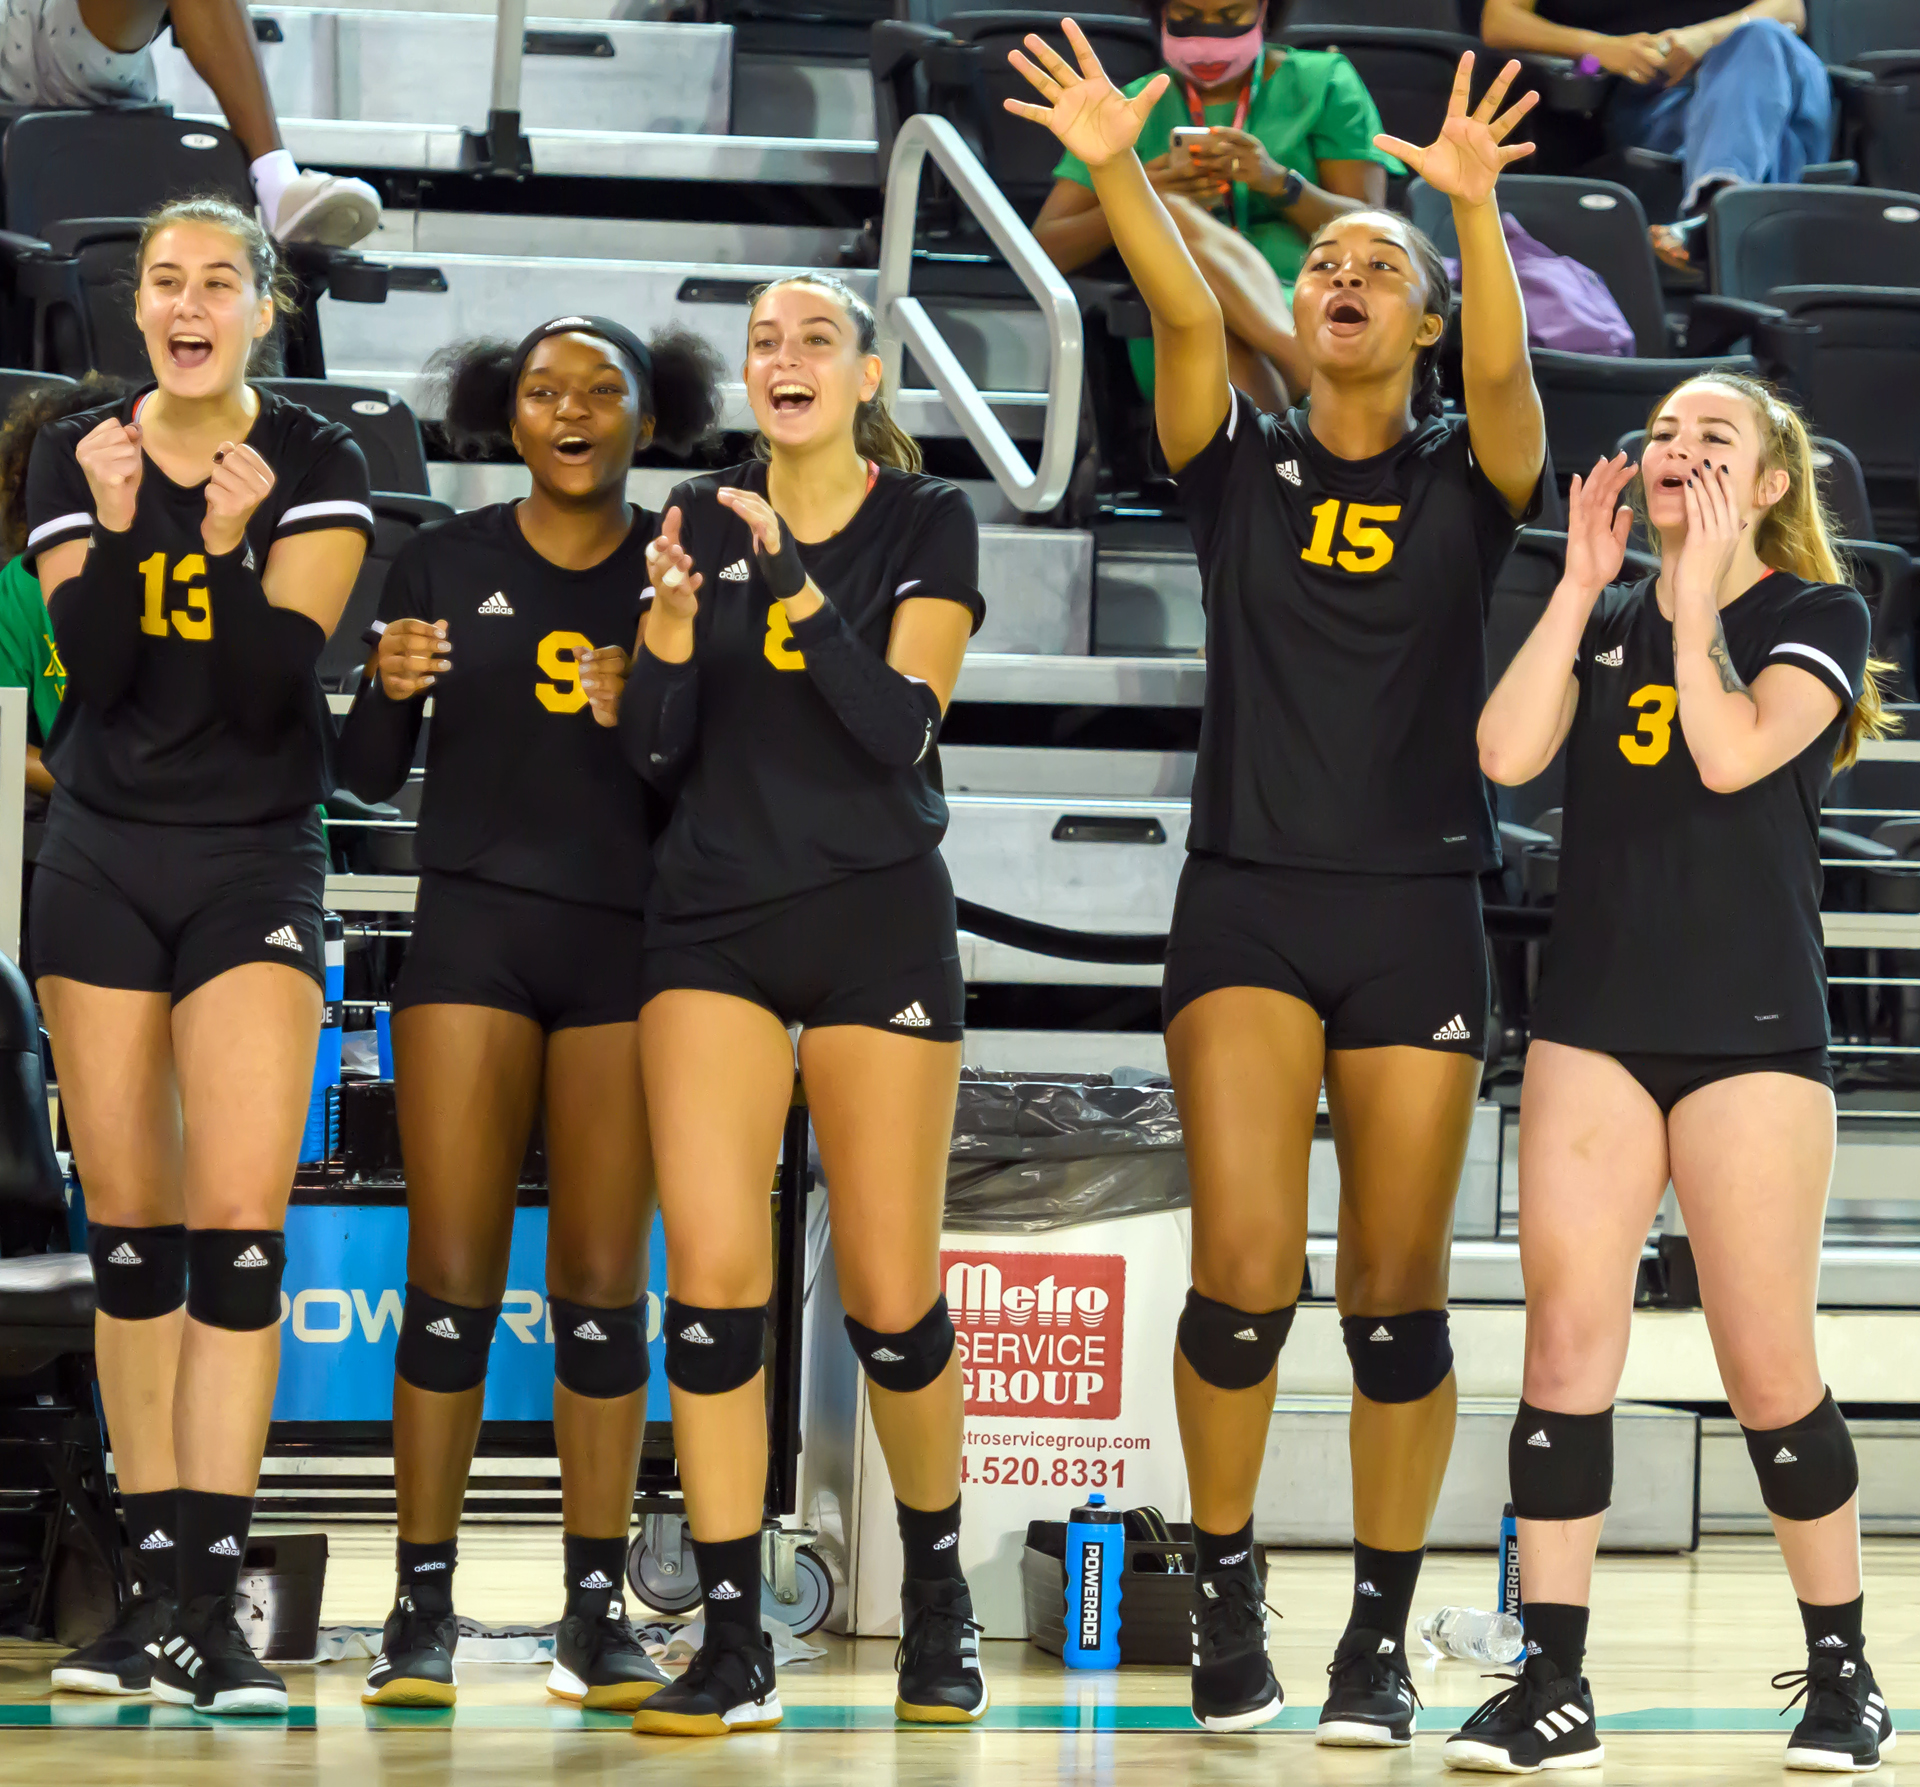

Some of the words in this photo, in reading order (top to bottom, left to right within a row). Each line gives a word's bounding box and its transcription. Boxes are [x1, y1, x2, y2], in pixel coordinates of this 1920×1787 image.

[1301, 499, 1401, 572] 15
[139, 552, 213, 640] 13
[535, 631, 594, 713] 9
[1618, 684, 1678, 765] 3
[265, 936, 303, 951] adidas
[946, 1262, 1109, 1327] Metro
[426, 1325, 460, 1339] adidas
[962, 1429, 1151, 1451] troservicegroup.com
[414, 1561, 446, 1572] adidas
[1083, 1545, 1099, 1646] POWERADE
[1506, 1541, 1519, 1615] WERADE
